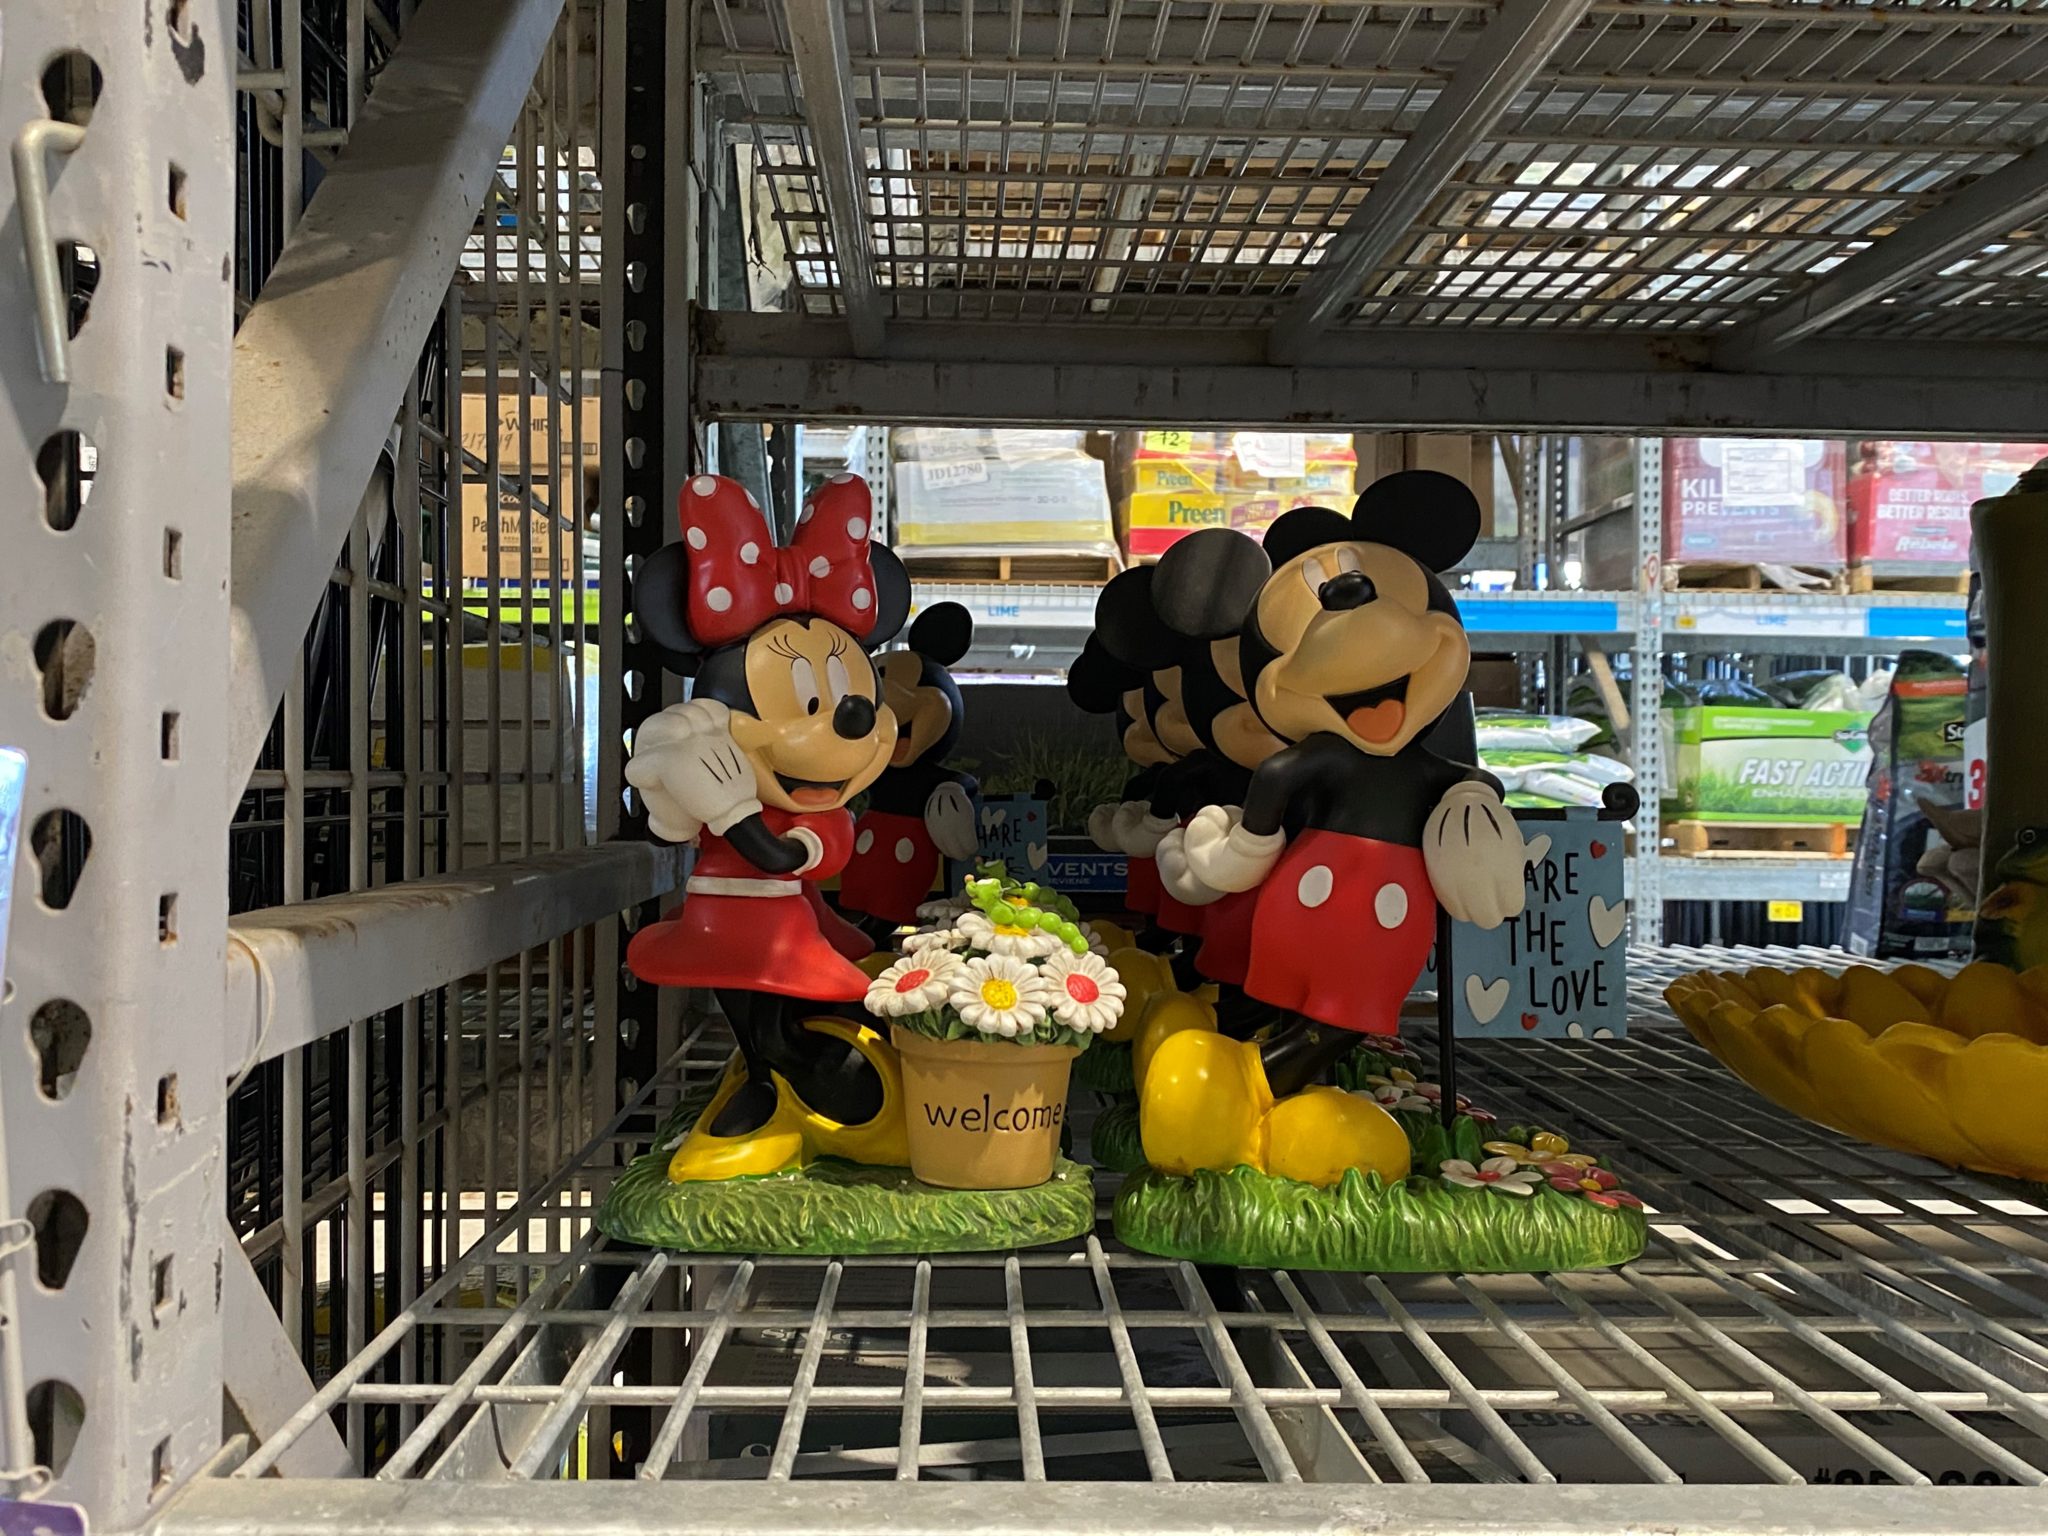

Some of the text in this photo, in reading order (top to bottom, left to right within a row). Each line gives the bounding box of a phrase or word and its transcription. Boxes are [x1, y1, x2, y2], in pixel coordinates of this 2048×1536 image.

[1156, 470, 1193, 486] Preen
[1682, 478, 1723, 498] KIL
[1168, 500, 1226, 525] Preen
[988, 605, 1020, 617] LIME
[1738, 758, 1868, 787] FAST ACTI
[977, 818, 1022, 848] HARE
[1047, 862, 1129, 876] VENTS
[1523, 852, 1580, 904] ARE
[1503, 909, 1567, 967] THE
[1529, 959, 1609, 1016] LOVE
[923, 1093, 1062, 1133] welcome
